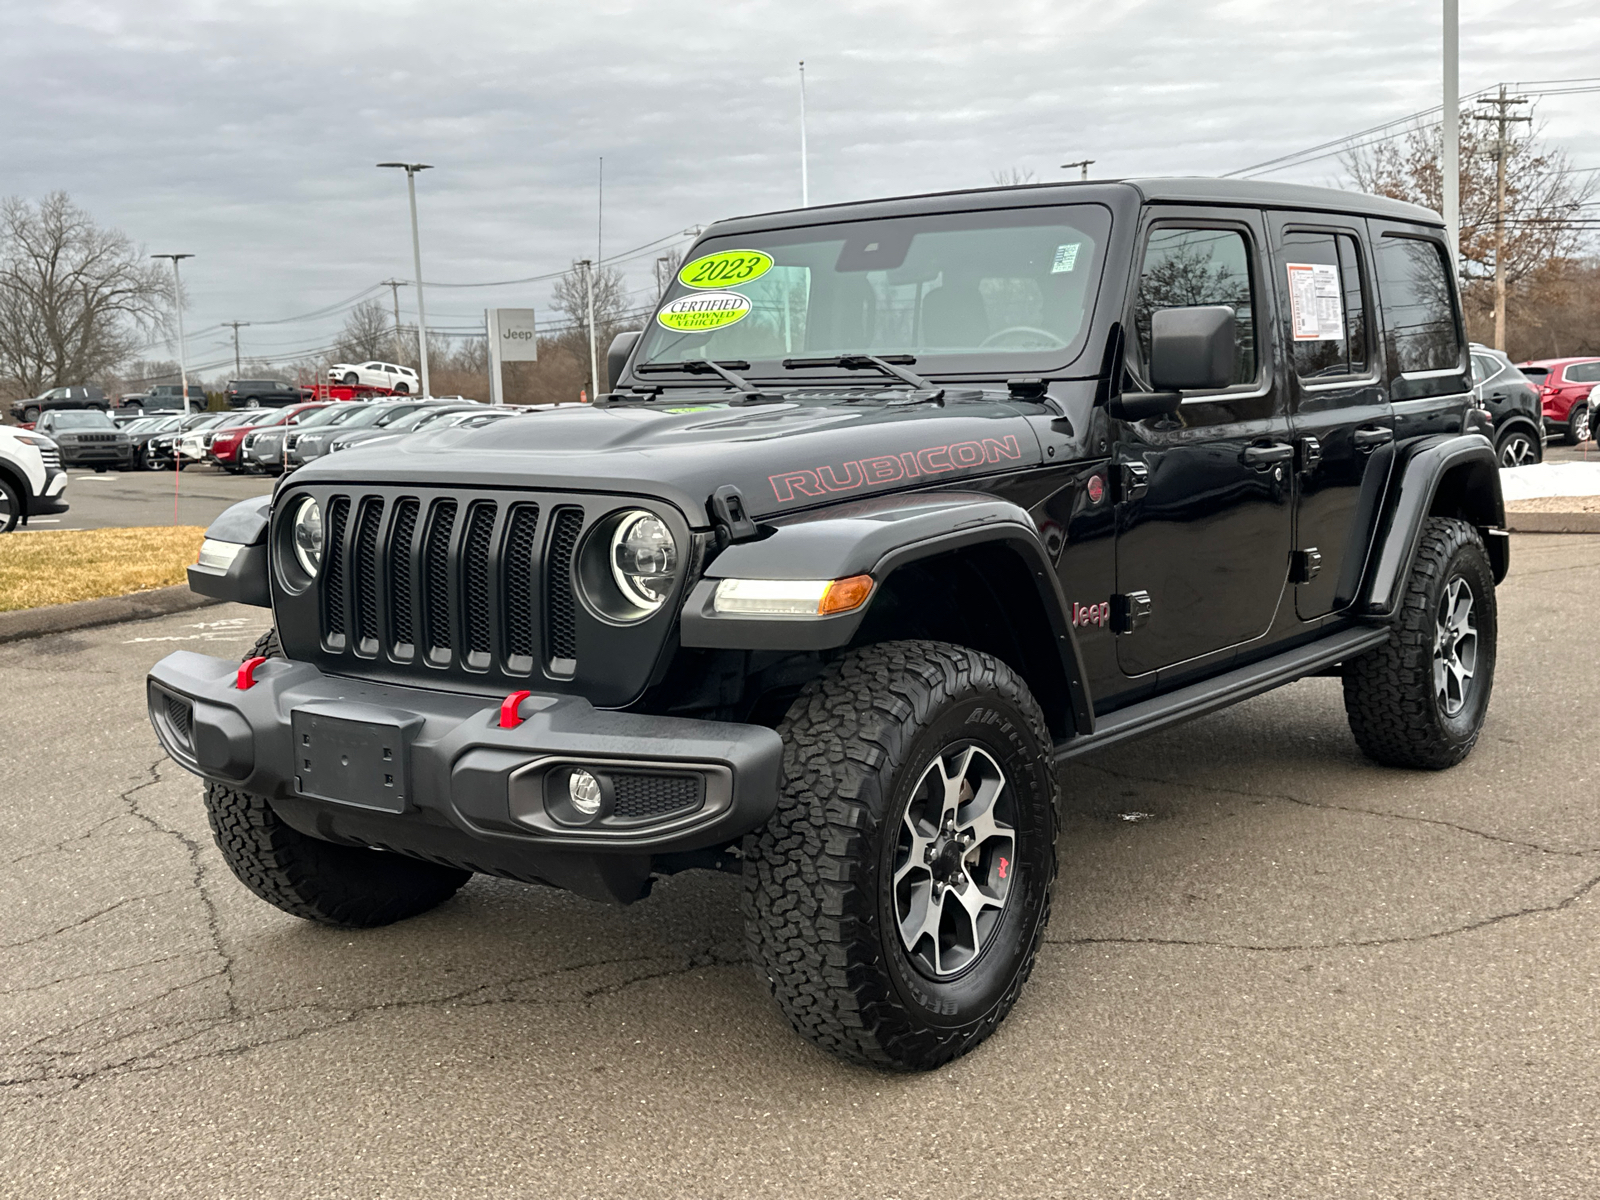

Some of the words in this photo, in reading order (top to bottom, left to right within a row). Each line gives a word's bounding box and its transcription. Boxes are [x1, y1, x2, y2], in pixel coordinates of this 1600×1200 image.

[690, 256, 761, 283] 2023
[671, 299, 743, 313] CERTIFIED
[669, 311, 735, 321] PRE-OWNED
[677, 318, 722, 327] VEHICLE
[502, 328, 533, 341] Jeep
[768, 435, 1022, 502] RUBICON
[1072, 601, 1111, 629] Jeep
